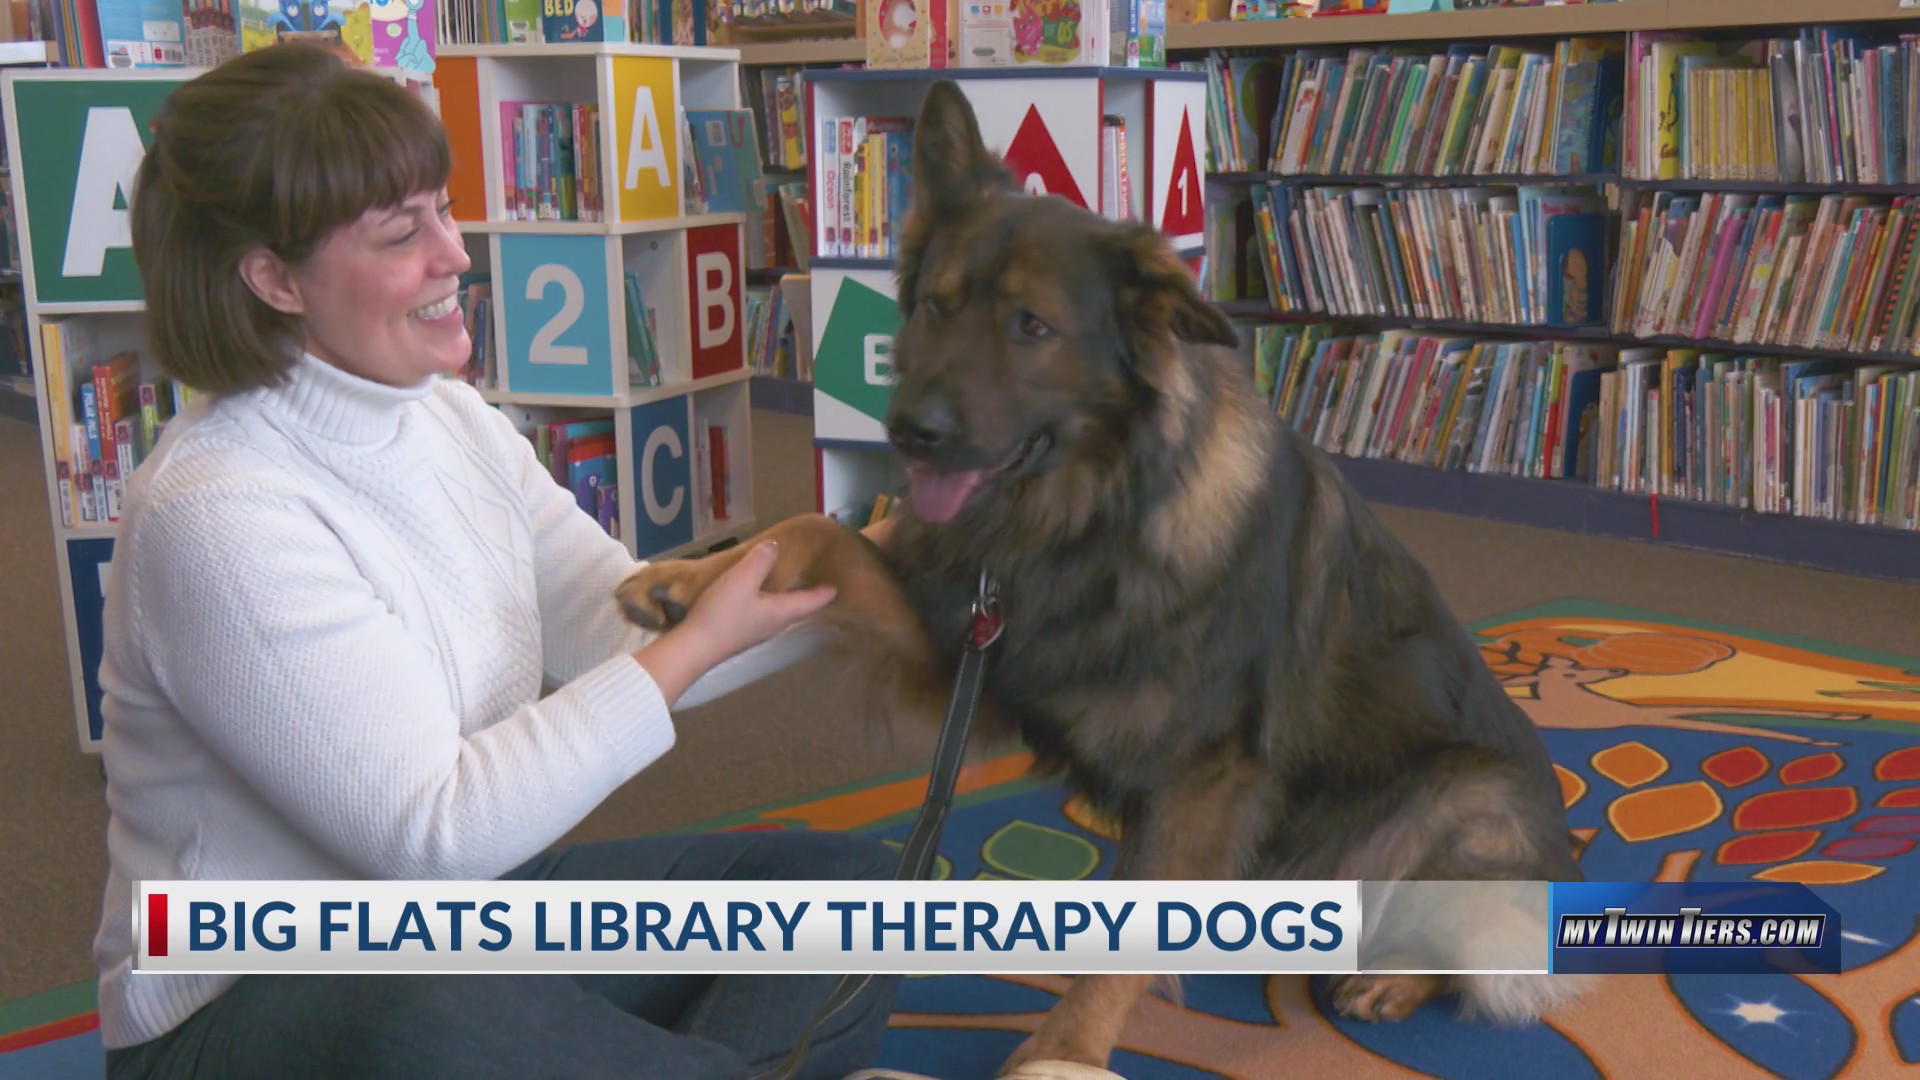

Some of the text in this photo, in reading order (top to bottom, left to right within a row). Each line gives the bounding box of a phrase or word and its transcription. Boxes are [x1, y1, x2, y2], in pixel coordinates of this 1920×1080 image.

[625, 86, 671, 190] A
[62, 106, 146, 278] A
[826, 170, 835, 209] Ocean
[842, 161, 853, 222] Rainforest
[1177, 166, 1188, 217] 1
[525, 263, 588, 365] 2
[696, 251, 735, 350] B
[641, 424, 685, 527] C
